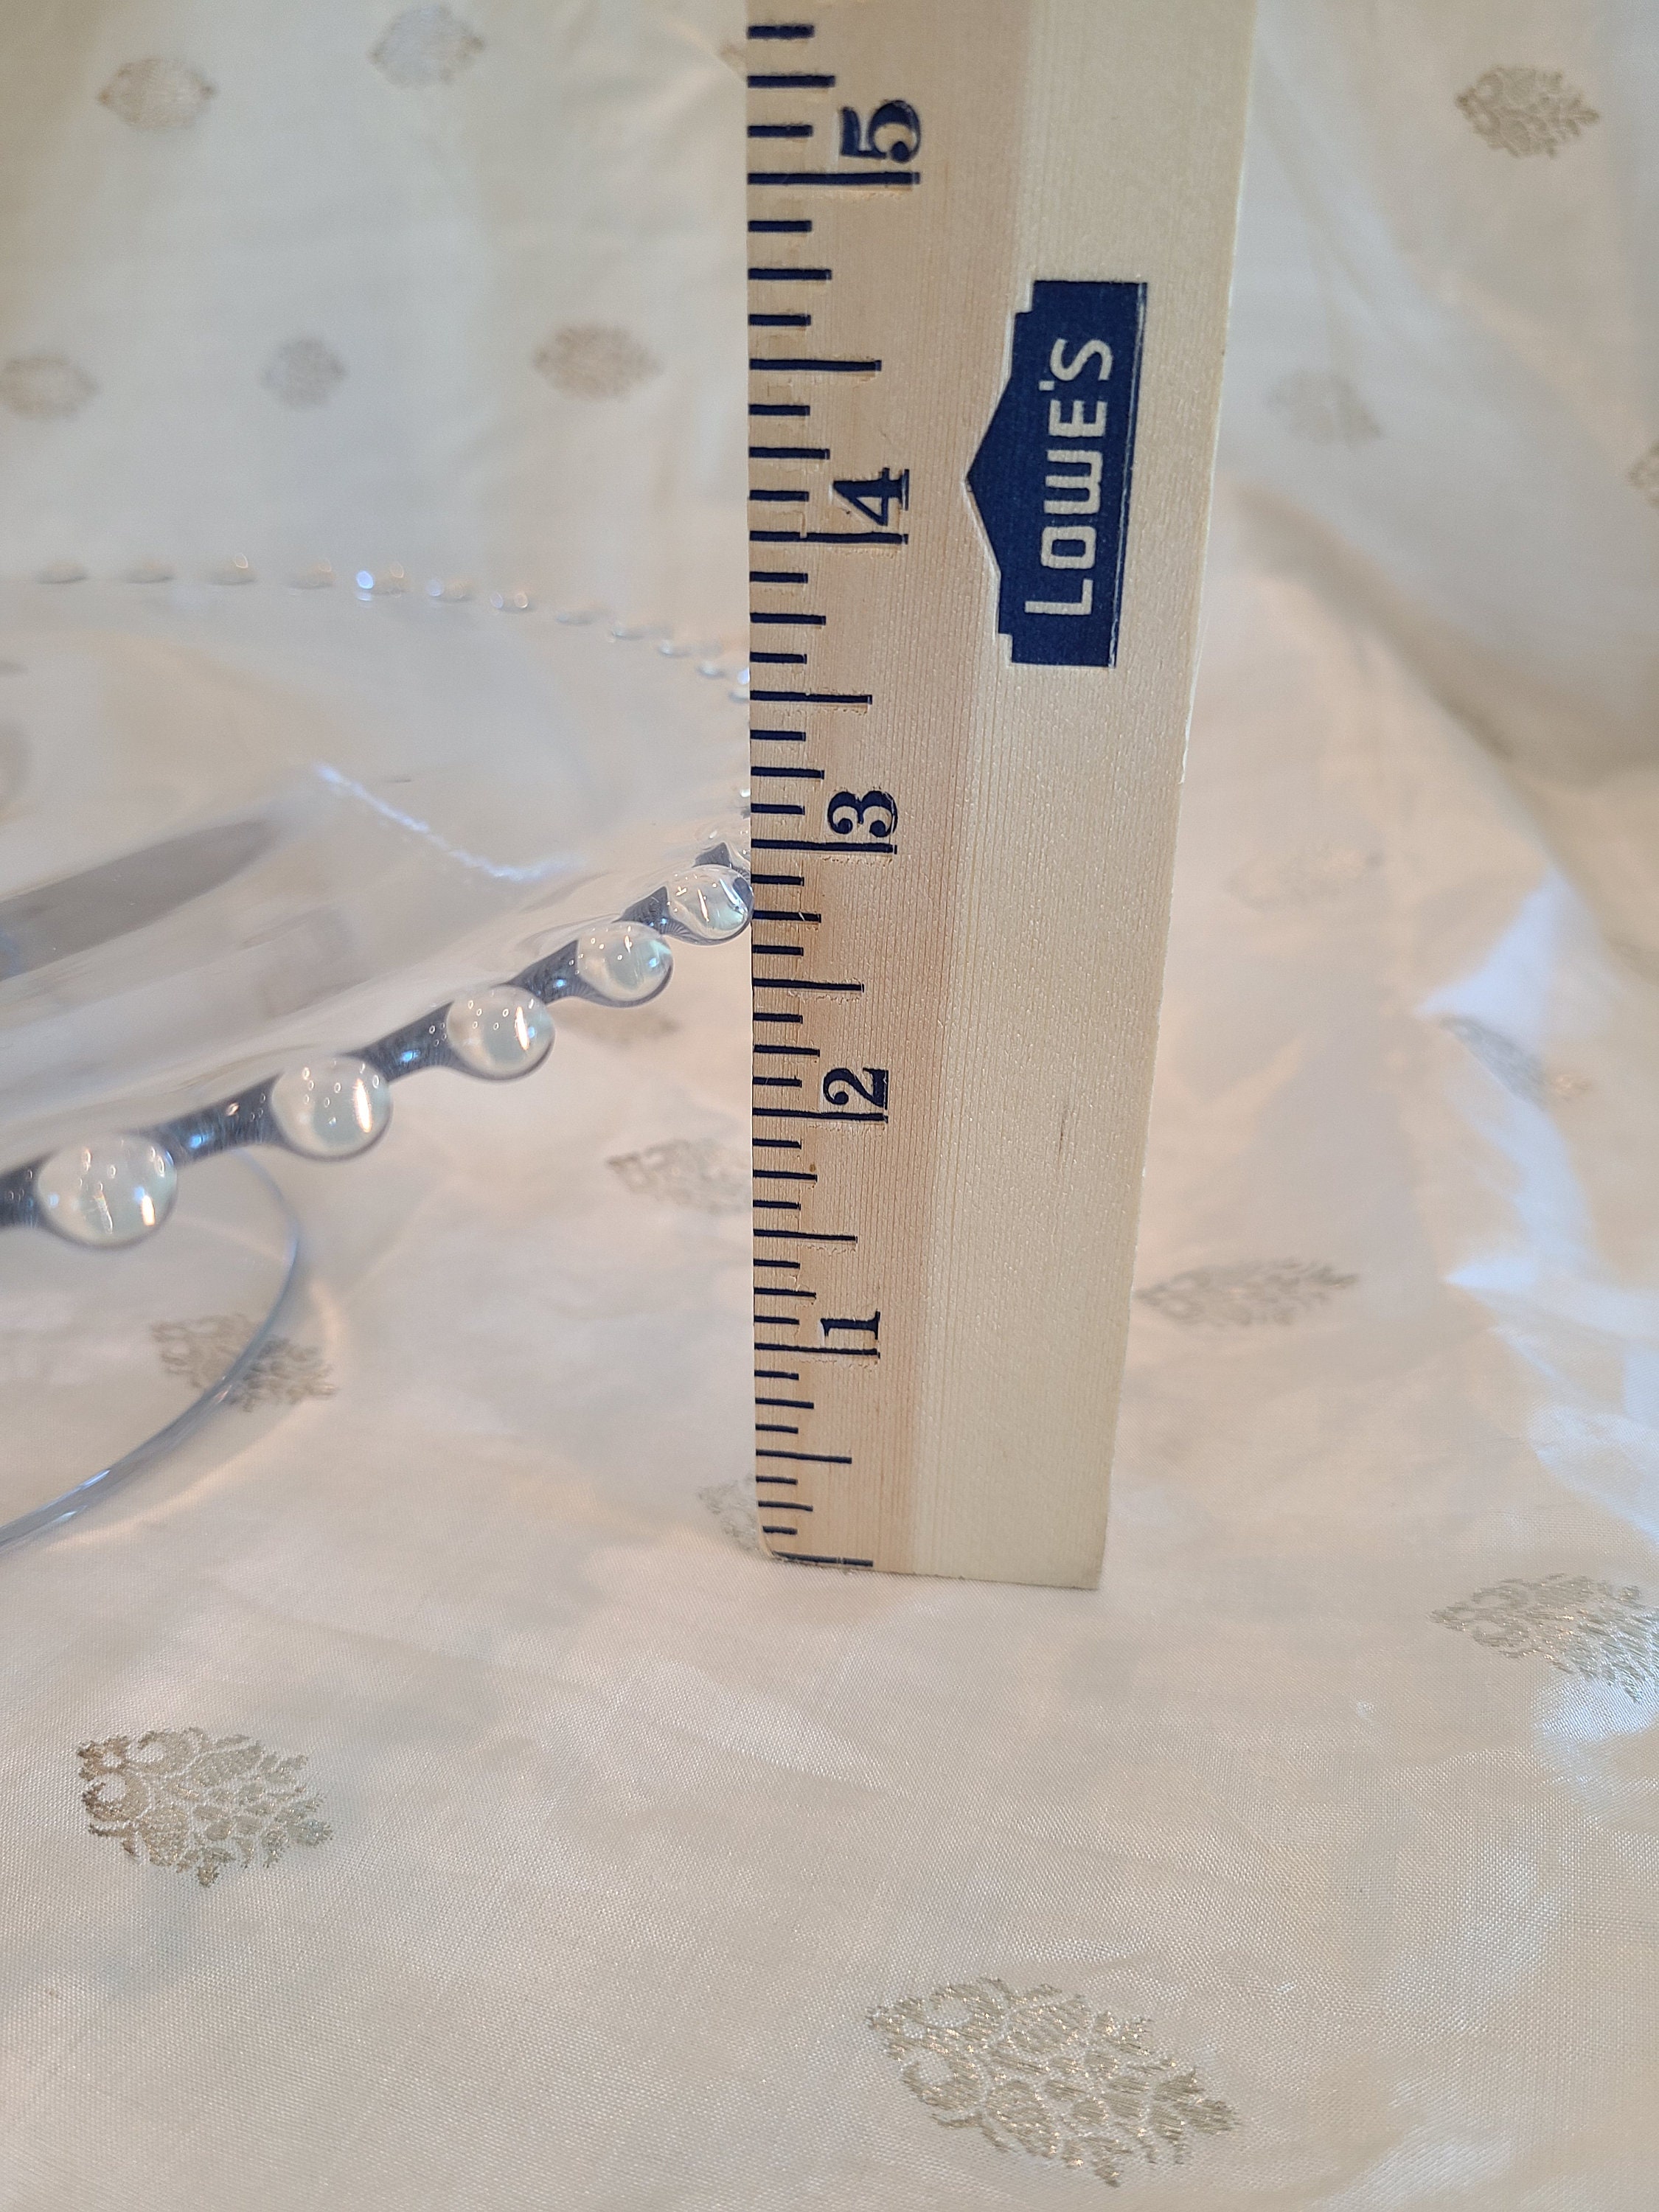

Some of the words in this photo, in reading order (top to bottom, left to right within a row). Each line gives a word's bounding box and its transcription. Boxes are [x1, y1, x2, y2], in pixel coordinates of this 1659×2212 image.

[838, 99, 922, 164] 5
[832, 467, 910, 526] 4
[1024, 338, 1114, 616] LOWE'S
[827, 787, 899, 838] 3
[822, 1066, 889, 1111] 2
[819, 1310, 881, 1342] 1
